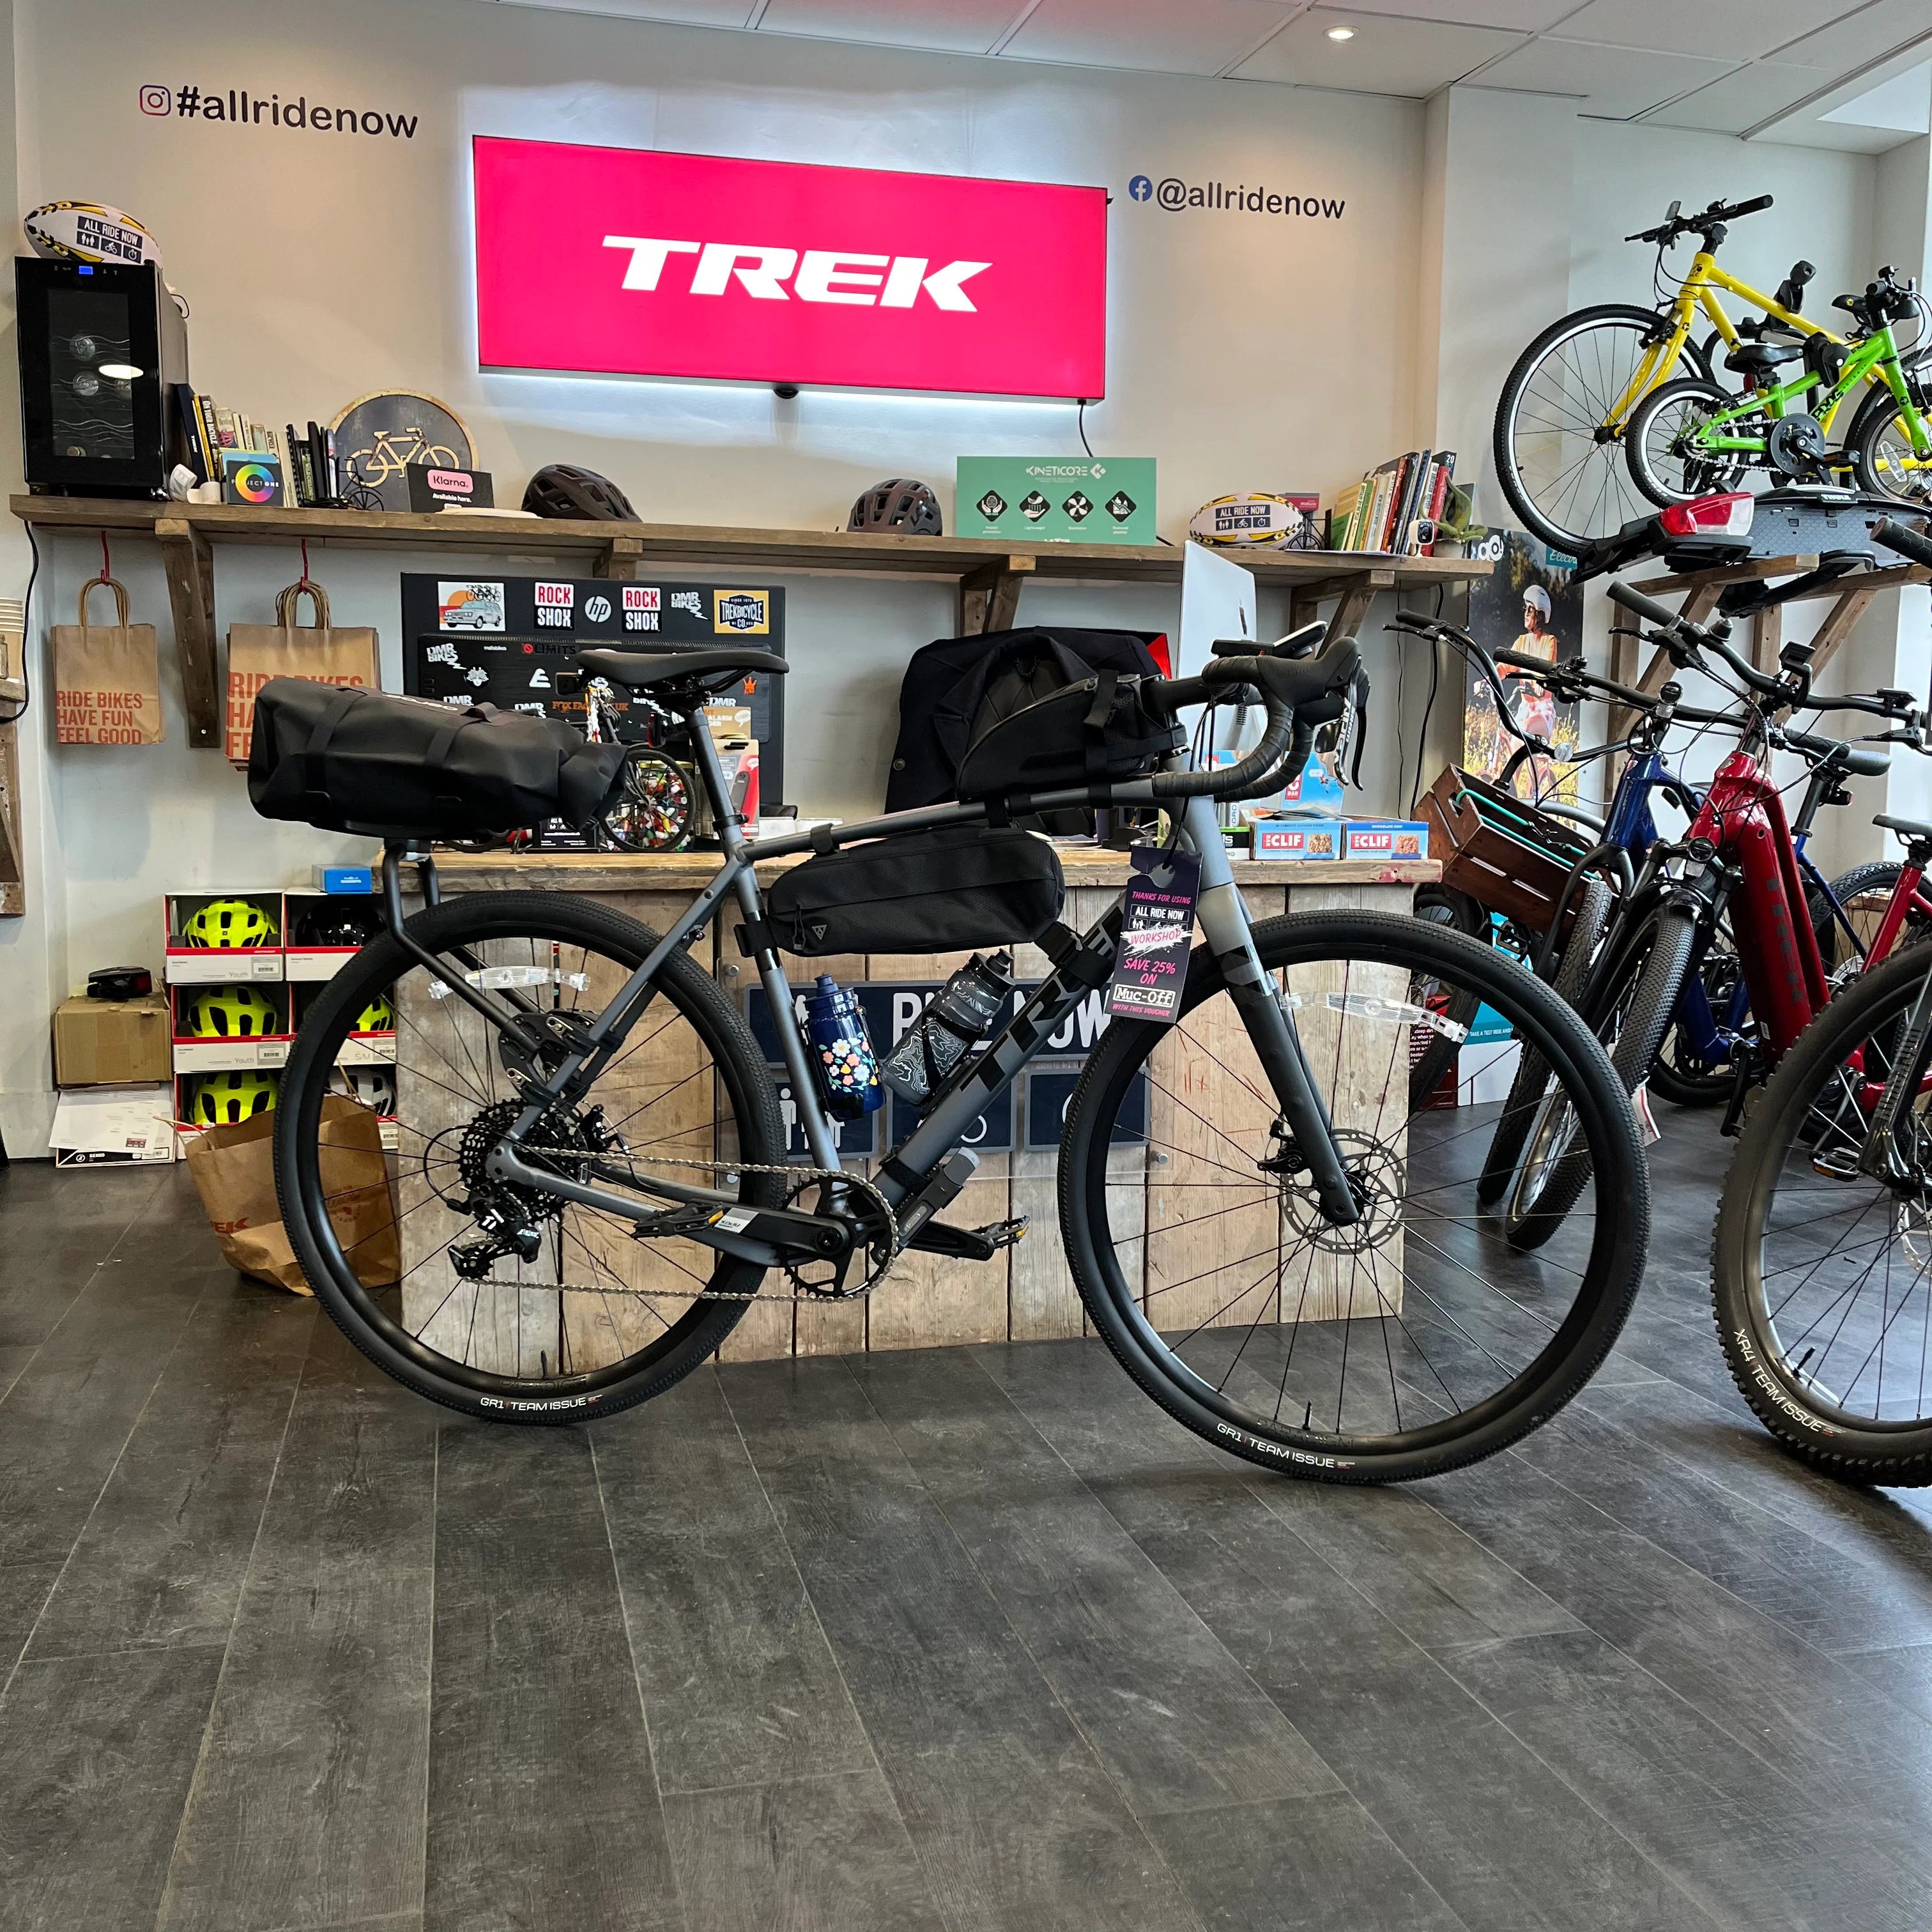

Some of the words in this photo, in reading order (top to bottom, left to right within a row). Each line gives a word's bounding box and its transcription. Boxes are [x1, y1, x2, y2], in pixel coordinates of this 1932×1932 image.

[177, 84, 418, 139] #allridenow
[1157, 177, 1346, 219] @allridenow
[84, 219, 100, 233] ALL
[102, 226, 119, 239] RIDE
[121, 232, 138, 245] NOW
[602, 235, 993, 312] TREK
[204, 410, 213, 423] YOUR
[207, 424, 217, 445] BICYCLE
[1446, 454, 1455, 464] 20
[1025, 466, 1088, 476] KINETICORE
[1220, 509, 1232, 517] ALL
[1234, 507, 1248, 516] RIDE
[1250, 505, 1266, 514] NOW
[538, 586, 571, 604] ROCK
[625, 590, 657, 608] ROCK
[671, 592, 700, 601] DMR
[588, 597, 608, 622] hp
[671, 600, 702, 610] BIKES
[537, 611, 572, 628] SHOX
[625, 612, 659, 631] SHOX
[427, 643, 456, 654] DMR
[428, 652, 458, 662] BIKES
[56, 691, 94, 708] RIDE
[97, 693, 142, 709] BIKES
[443, 695, 473, 706] DMR
[709, 697, 736, 707] DMR
[57, 710, 97, 726] HAVE
[102, 710, 133, 726] FUN
[57, 728, 93, 744] FEEL
[98, 729, 141, 744] GOOD
[1271, 835, 1301, 847] CLIF
[1360, 836, 1389, 847] CLIF
[1132, 891, 1156, 901] THANKS
[1158, 894, 1170, 902] FOR
[1171, 896, 1192, 905] USING
[1135, 906, 1148, 916] ALL
[1150, 908, 1166, 919] RIDE
[1167, 909, 1184, 920] NOW
[1131, 930, 1182, 944] WORKSHOP
[1124, 958, 1151, 972] SAVE
[1151, 961, 1176, 974] 25%
[1140, 973, 1158, 985] ON
[1116, 987, 1172, 1006] Muc-Off
[1112, 1003, 1128, 1011] WITH
[1130, 1005, 1143, 1013] THIS
[1144, 1006, 1170, 1017] VOUCHER
[1733, 1328, 1756, 1362] XR4
[1751, 1364, 1786, 1405] TEAM
[1781, 1402, 1823, 1432] ISSUE
[480, 1397, 504, 1409] GR1
[510, 1402, 547, 1411] TEAM
[549, 1397, 586, 1410] ISSUE
[1216, 1423, 1242, 1443] GR1
[1249, 1438, 1290, 1459] TEAM
[1292, 1452, 1335, 1468] ISSUE
